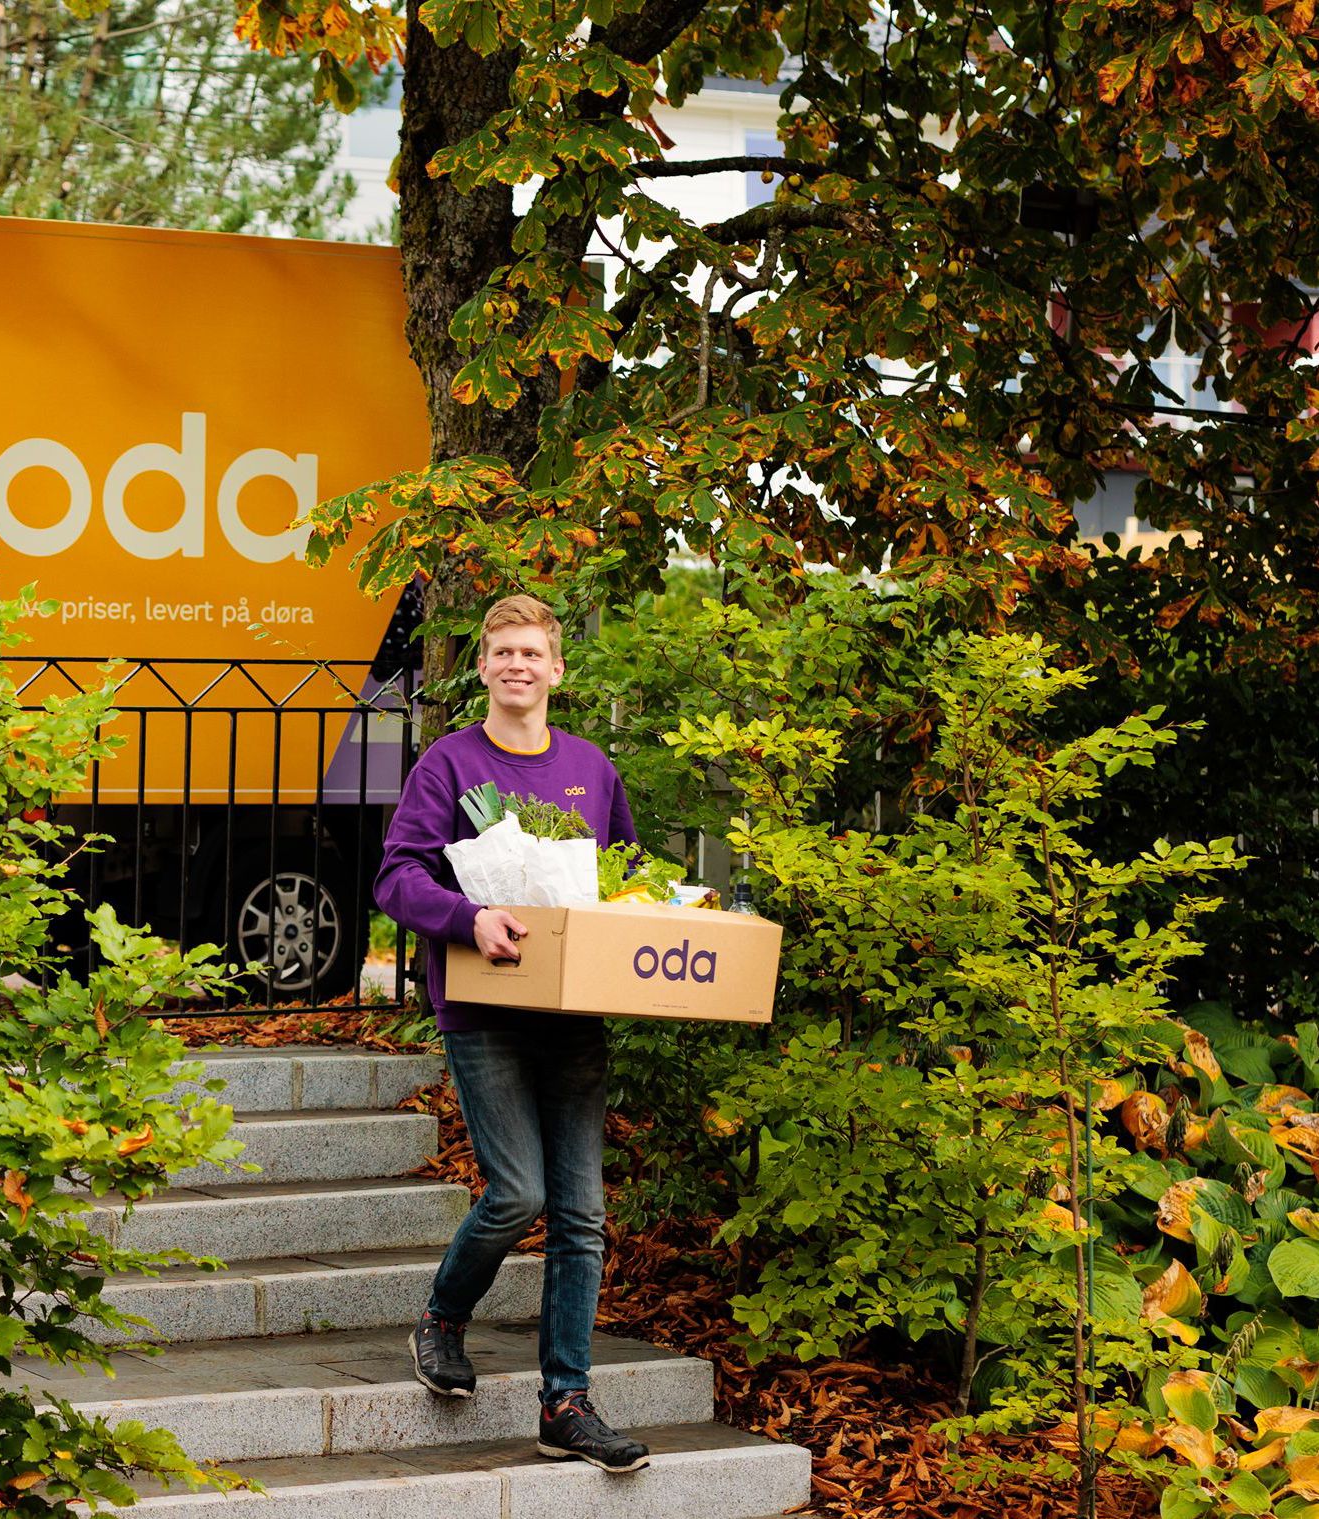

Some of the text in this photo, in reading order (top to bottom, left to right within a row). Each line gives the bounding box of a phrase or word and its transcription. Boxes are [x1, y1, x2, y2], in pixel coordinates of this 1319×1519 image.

[62, 596, 137, 625] priser,
[145, 596, 214, 622] levert
[222, 597, 251, 628] på
[260, 600, 314, 624] døra
[565, 785, 586, 796] oda
[633, 939, 717, 983] oda
